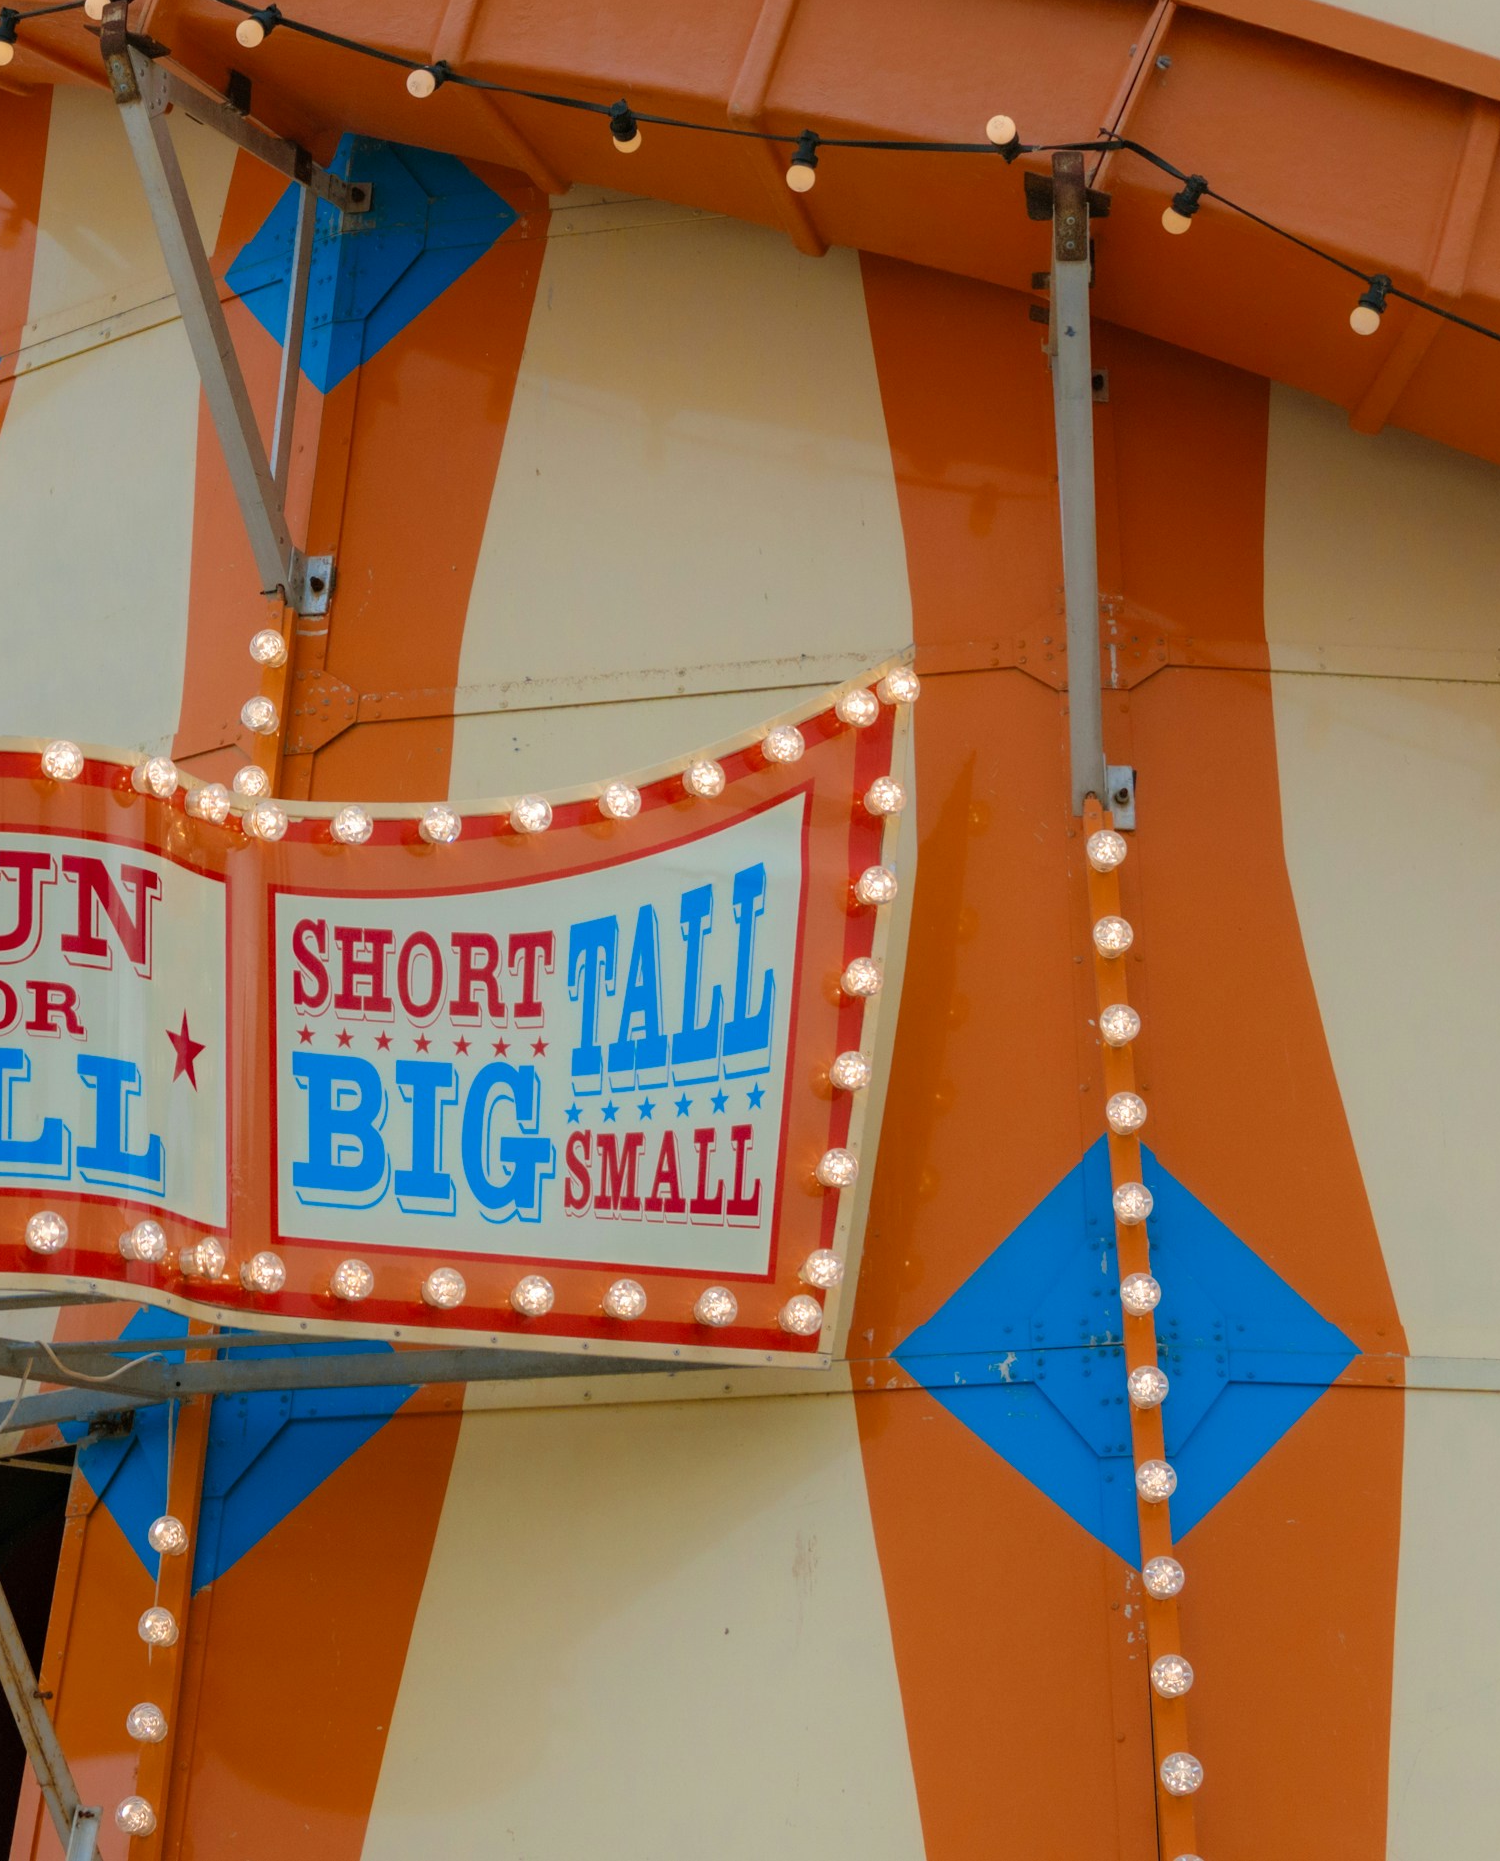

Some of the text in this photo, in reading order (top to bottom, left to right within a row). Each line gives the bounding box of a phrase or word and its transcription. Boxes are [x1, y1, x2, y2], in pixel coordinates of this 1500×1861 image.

[292, 918, 556, 1029] SHORT
[567, 861, 775, 1097] TALL
[291, 1050, 556, 1224] BIG
[563, 1123, 762, 1229] SMALL
